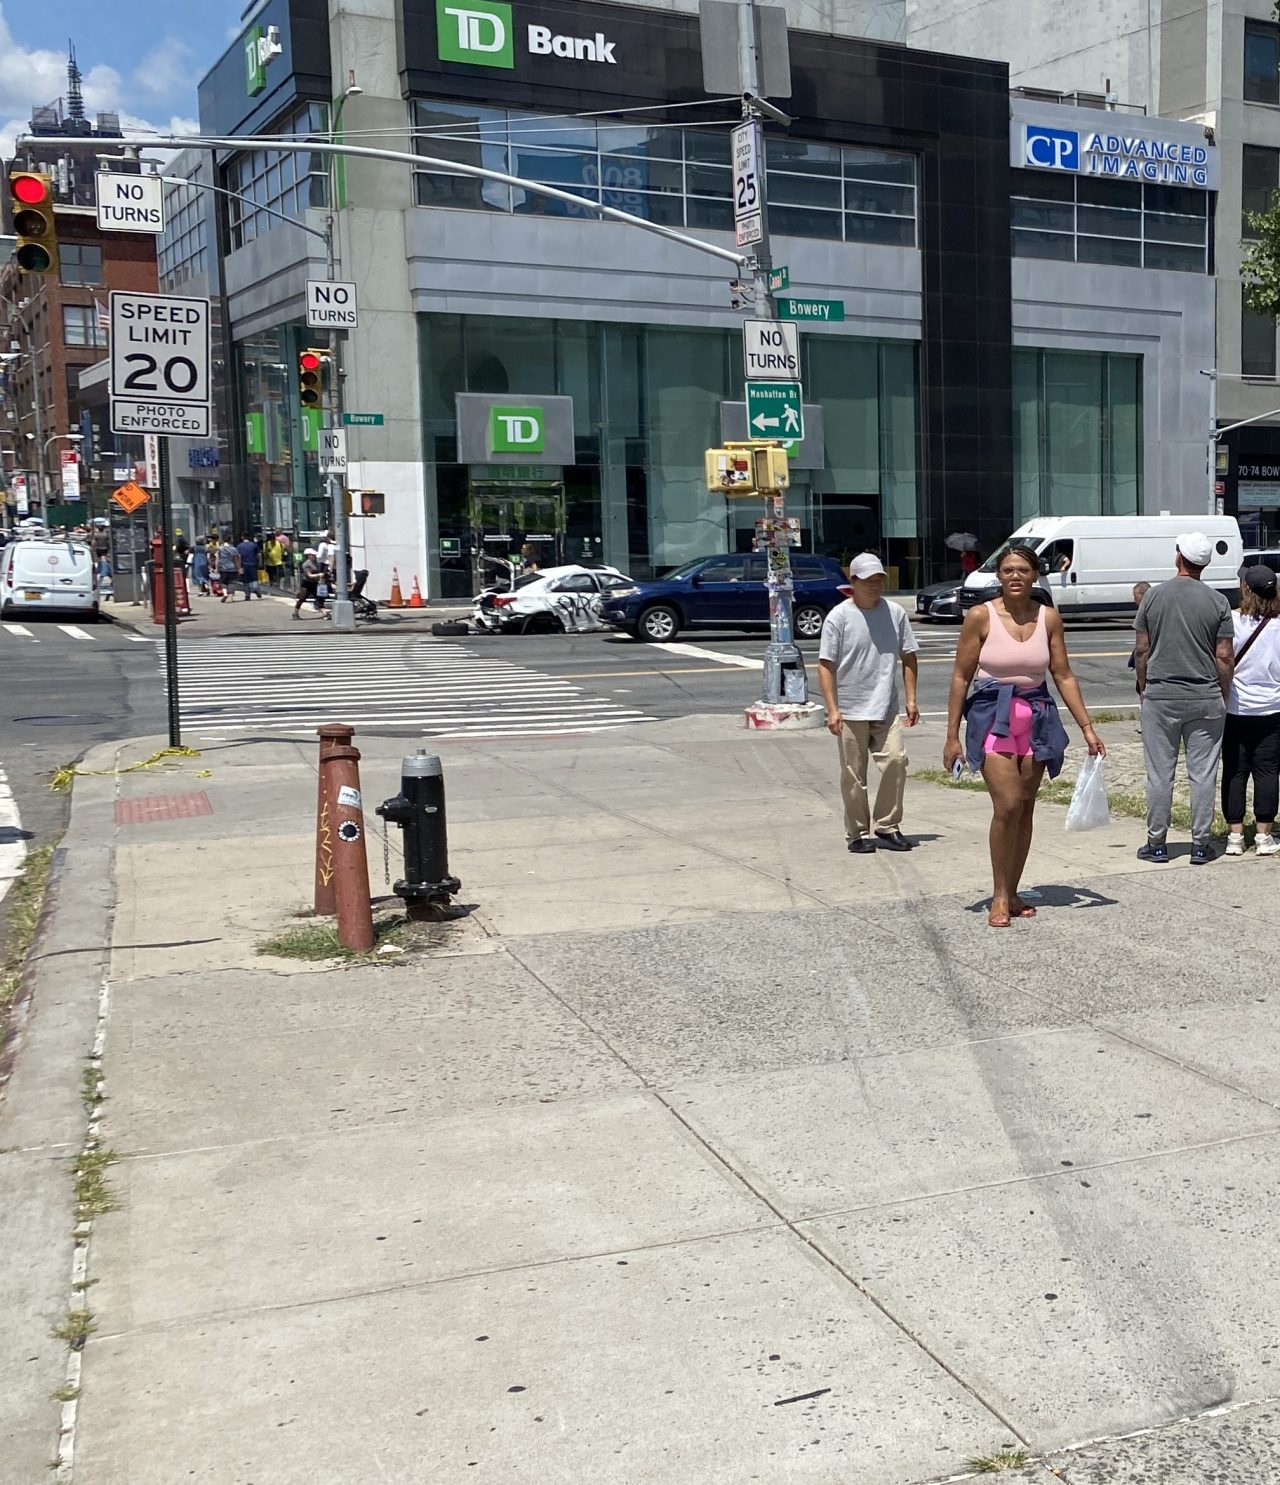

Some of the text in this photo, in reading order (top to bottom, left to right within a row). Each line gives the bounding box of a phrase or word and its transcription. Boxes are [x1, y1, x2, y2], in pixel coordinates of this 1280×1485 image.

[445, 7, 618, 65] TD Bank
[737, 130, 749, 143] CITY
[736, 144, 752, 158] SPEED
[1026, 135, 1074, 169] CP
[1088, 133, 1208, 166] ADVANCED
[738, 158, 751, 171] LIMIT
[1090, 154, 1208, 185] IMAGING
[116, 183, 144, 201] NO
[736, 172, 757, 209] 25
[101, 205, 161, 223] TURNS
[315, 286, 349, 304] NO
[120, 302, 201, 324] SPEED
[309, 309, 356, 323] TURNS
[788, 299, 830, 321] Bowery
[128, 325, 192, 346] LIMIT
[759, 330, 783, 347] NO
[748, 352, 797, 370] TURNS
[123, 352, 198, 394] 20
[750, 388, 798, 399] Manhattan Br
[136, 404, 186, 418] PHOTO
[349, 414, 376, 425] Bowery
[121, 415, 201, 431] ENFORCED
[497, 415, 540, 444] TD
[324, 435, 340, 449] NO
[319, 455, 347, 468] TURNS
[1238, 465, 1260, 476] 70-74
